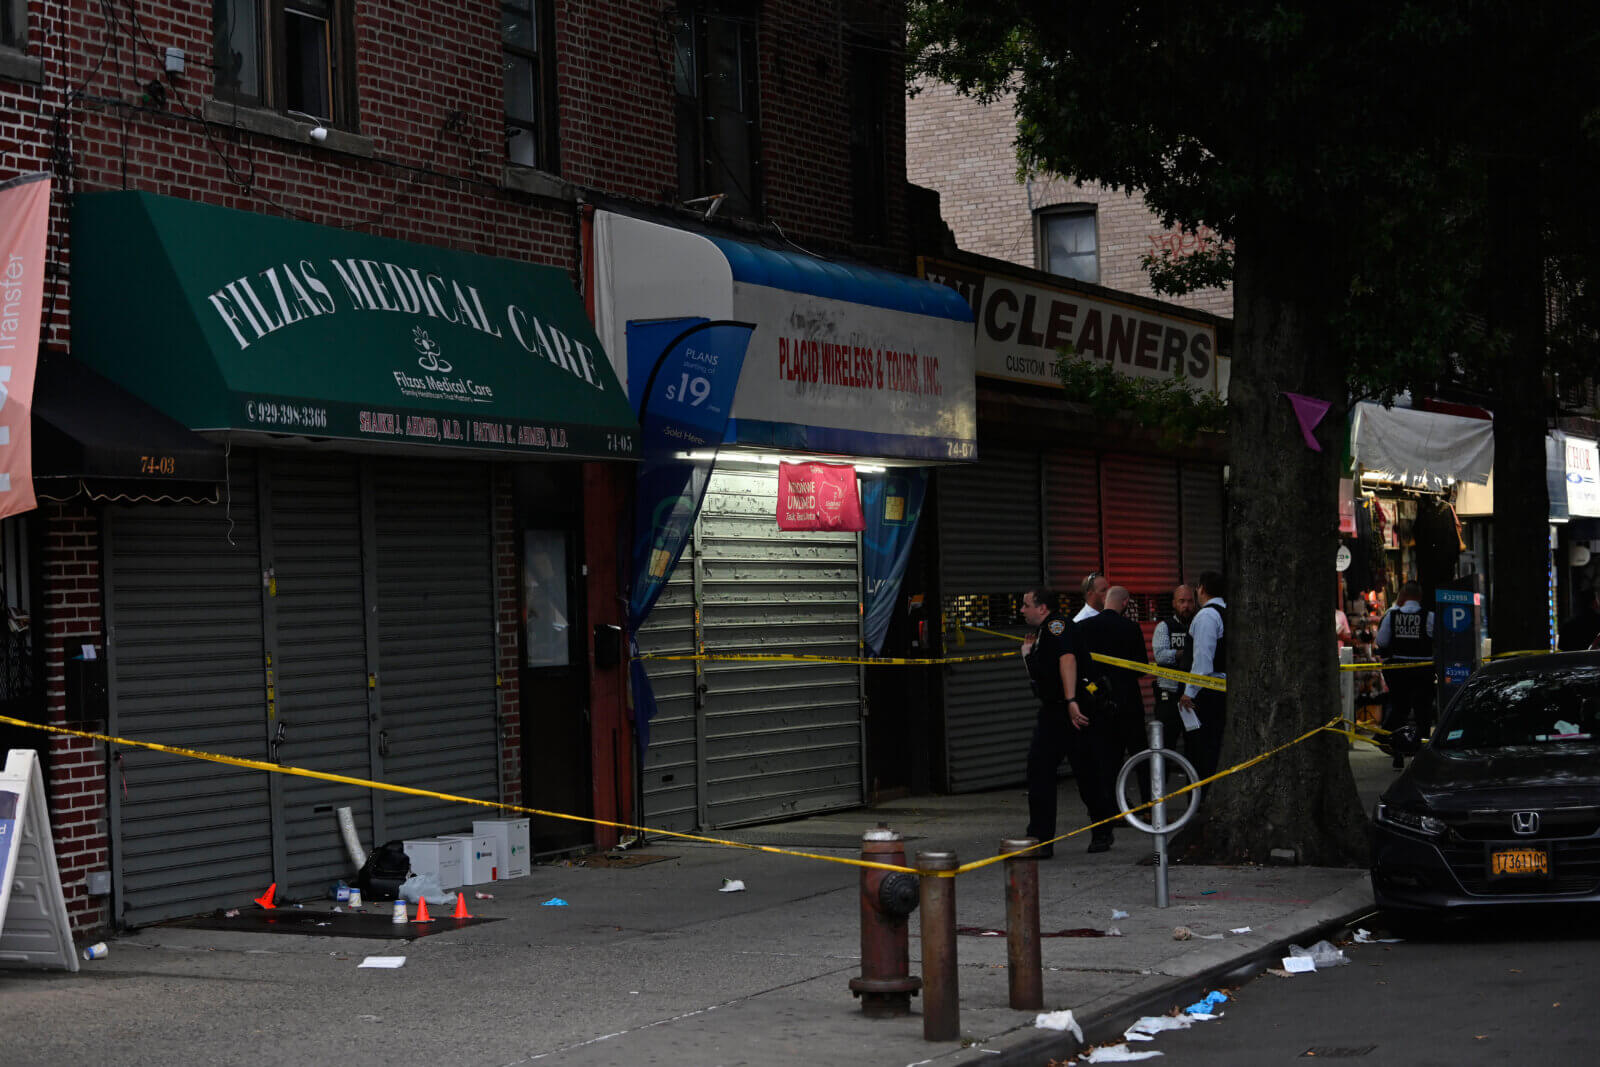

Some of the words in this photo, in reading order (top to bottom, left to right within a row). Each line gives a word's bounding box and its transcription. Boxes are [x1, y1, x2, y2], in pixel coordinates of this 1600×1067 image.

[208, 260, 335, 350] FILZAS
[329, 259, 502, 338] MEDICAL
[507, 304, 605, 392] CARE
[984, 288, 1210, 379] CLEANERS
[686, 348, 720, 366] PLANS
[779, 337, 819, 384] PLACID
[821, 341, 874, 389] WIRELESS
[876, 351, 884, 390] &
[886, 351, 922, 396] TOURS,
[923, 356, 943, 396] INC.
[1007, 355, 1046, 377] CUSTOM
[393, 370, 427, 389] Filzas
[425, 375, 468, 393] Medical
[466, 379, 493, 397] Care
[140, 455, 175, 475] 74-03
[1395, 613, 1421, 626] NYPD
[1451, 607, 1466, 629] P
